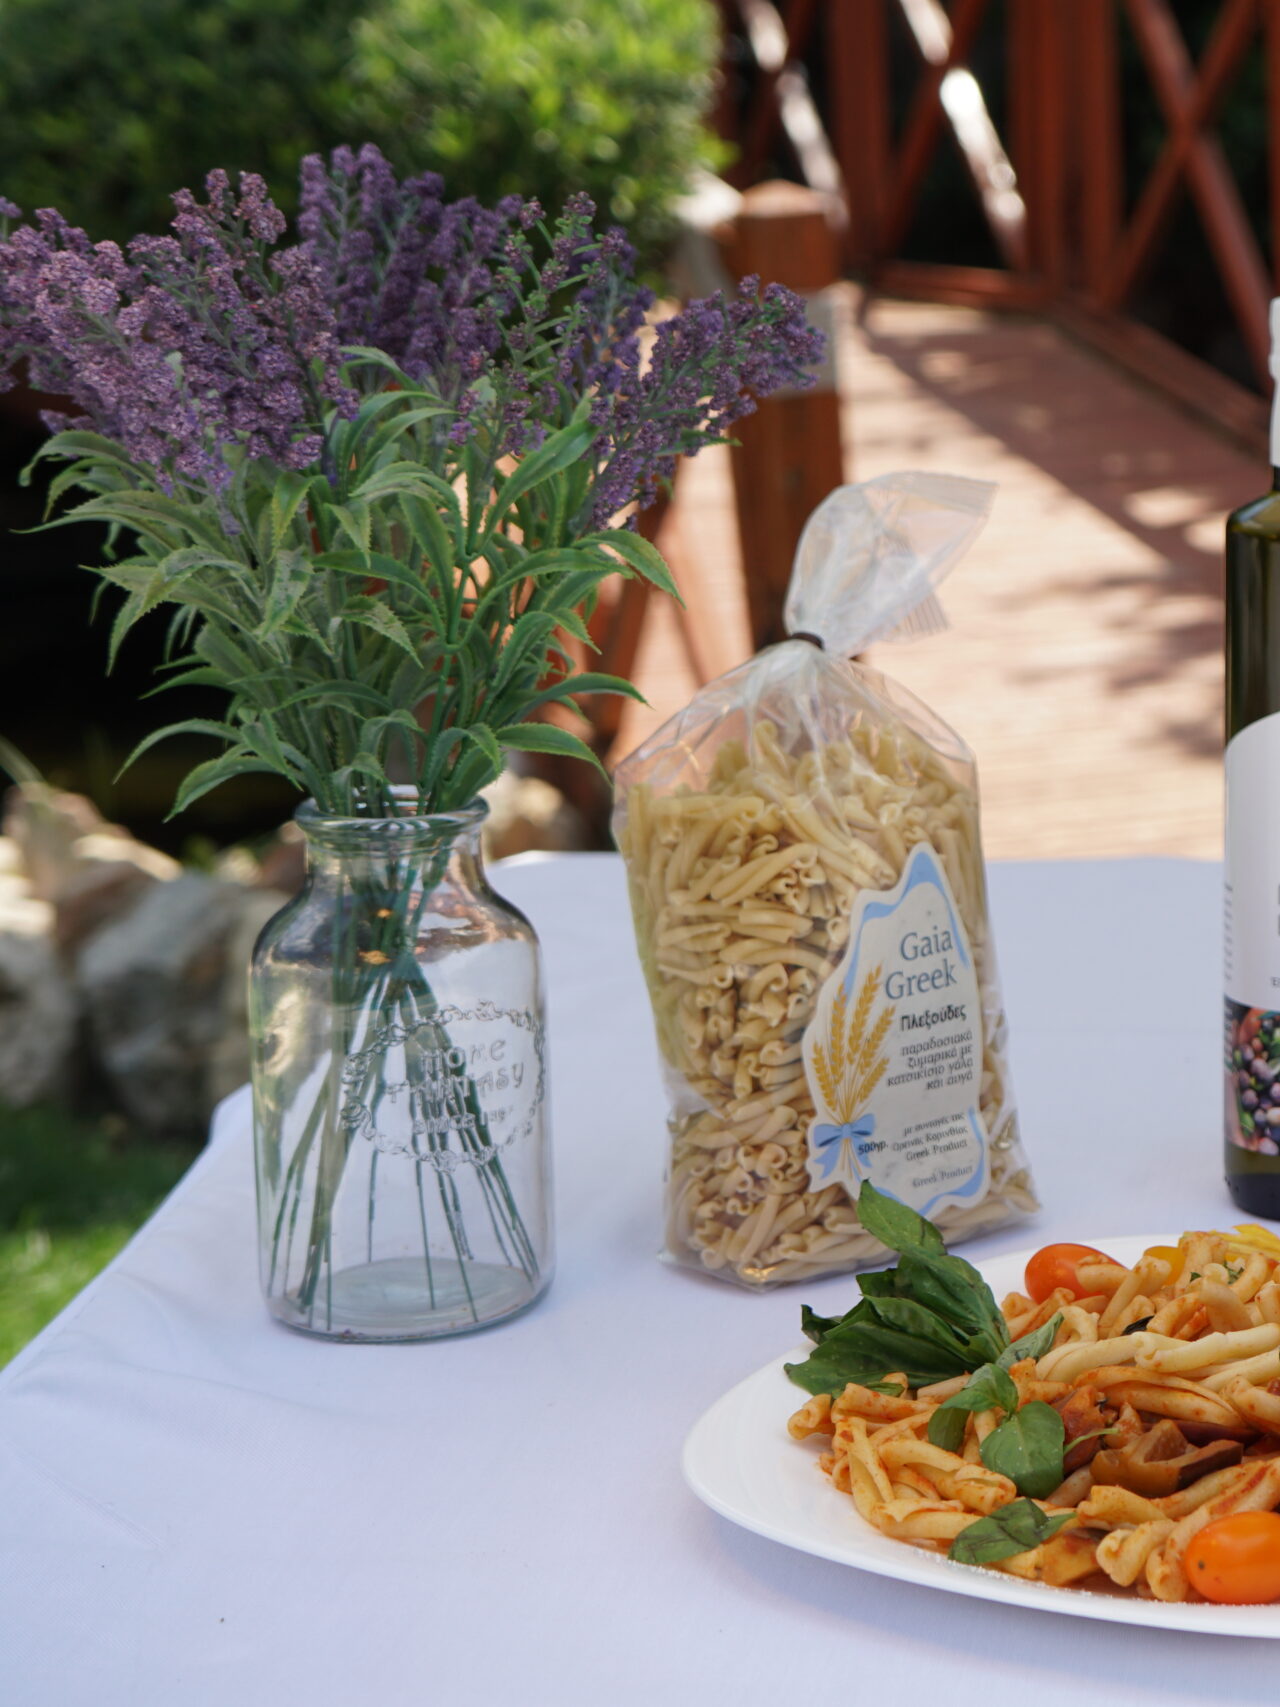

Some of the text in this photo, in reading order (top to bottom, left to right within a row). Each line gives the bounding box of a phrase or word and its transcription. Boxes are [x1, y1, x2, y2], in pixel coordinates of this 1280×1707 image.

[900, 925, 953, 961] Gaia
[885, 958, 957, 1000] Greek
[901, 1004, 966, 1031] Πλεξούδες
